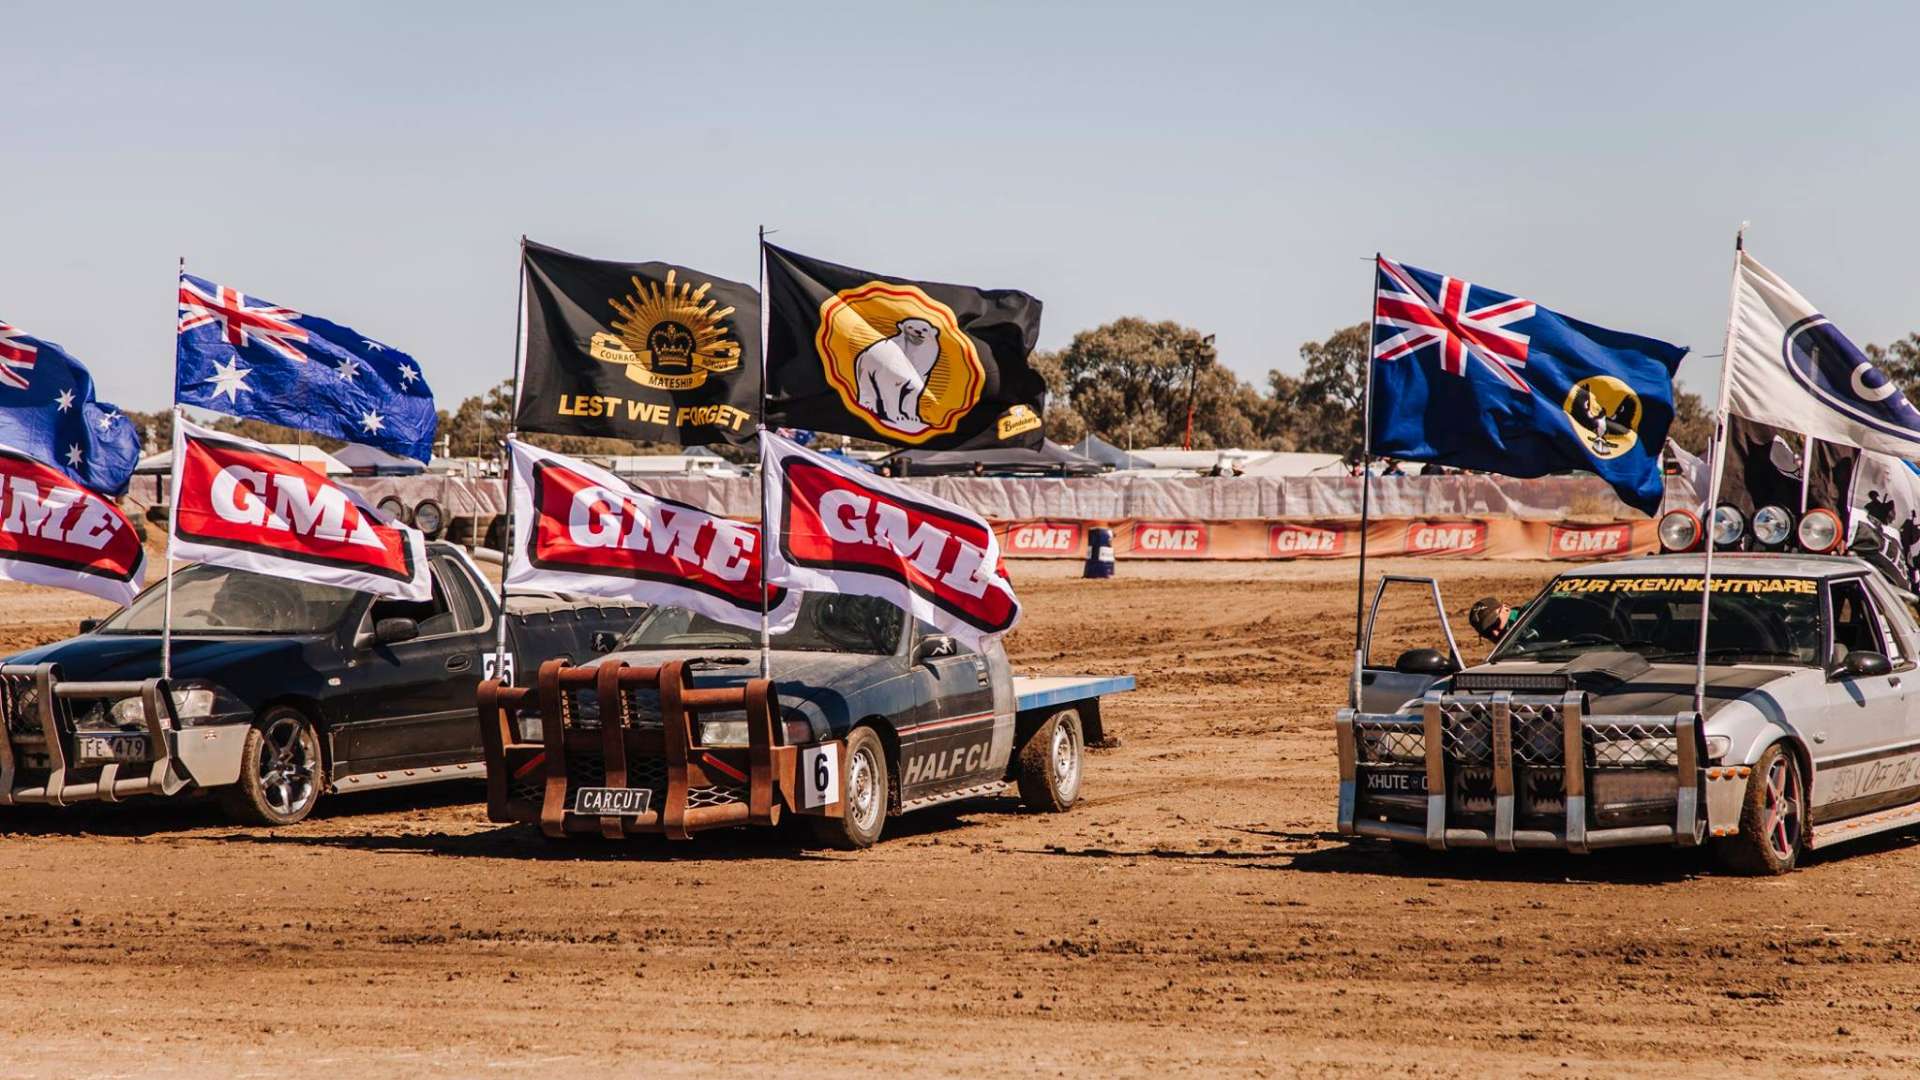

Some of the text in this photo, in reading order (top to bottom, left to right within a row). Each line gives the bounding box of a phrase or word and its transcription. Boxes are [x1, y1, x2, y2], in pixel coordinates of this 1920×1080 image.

[649, 376, 693, 388] MATESHIP
[558, 394, 751, 432] LEST WE FORGET
[0, 473, 123, 550] ME
[568, 486, 756, 582] GME
[818, 489, 998, 600] GME
[1014, 528, 1073, 549] GME
[1140, 528, 1200, 550] GME
[1277, 530, 1337, 552] GME
[1415, 528, 1477, 549] GME
[1559, 530, 1621, 552] GME
[1552, 579, 1610, 592] YOUR
[814, 752, 829, 792] 6
[1367, 774, 1409, 790] XHUTE
[583, 790, 644, 809] CARCUT
